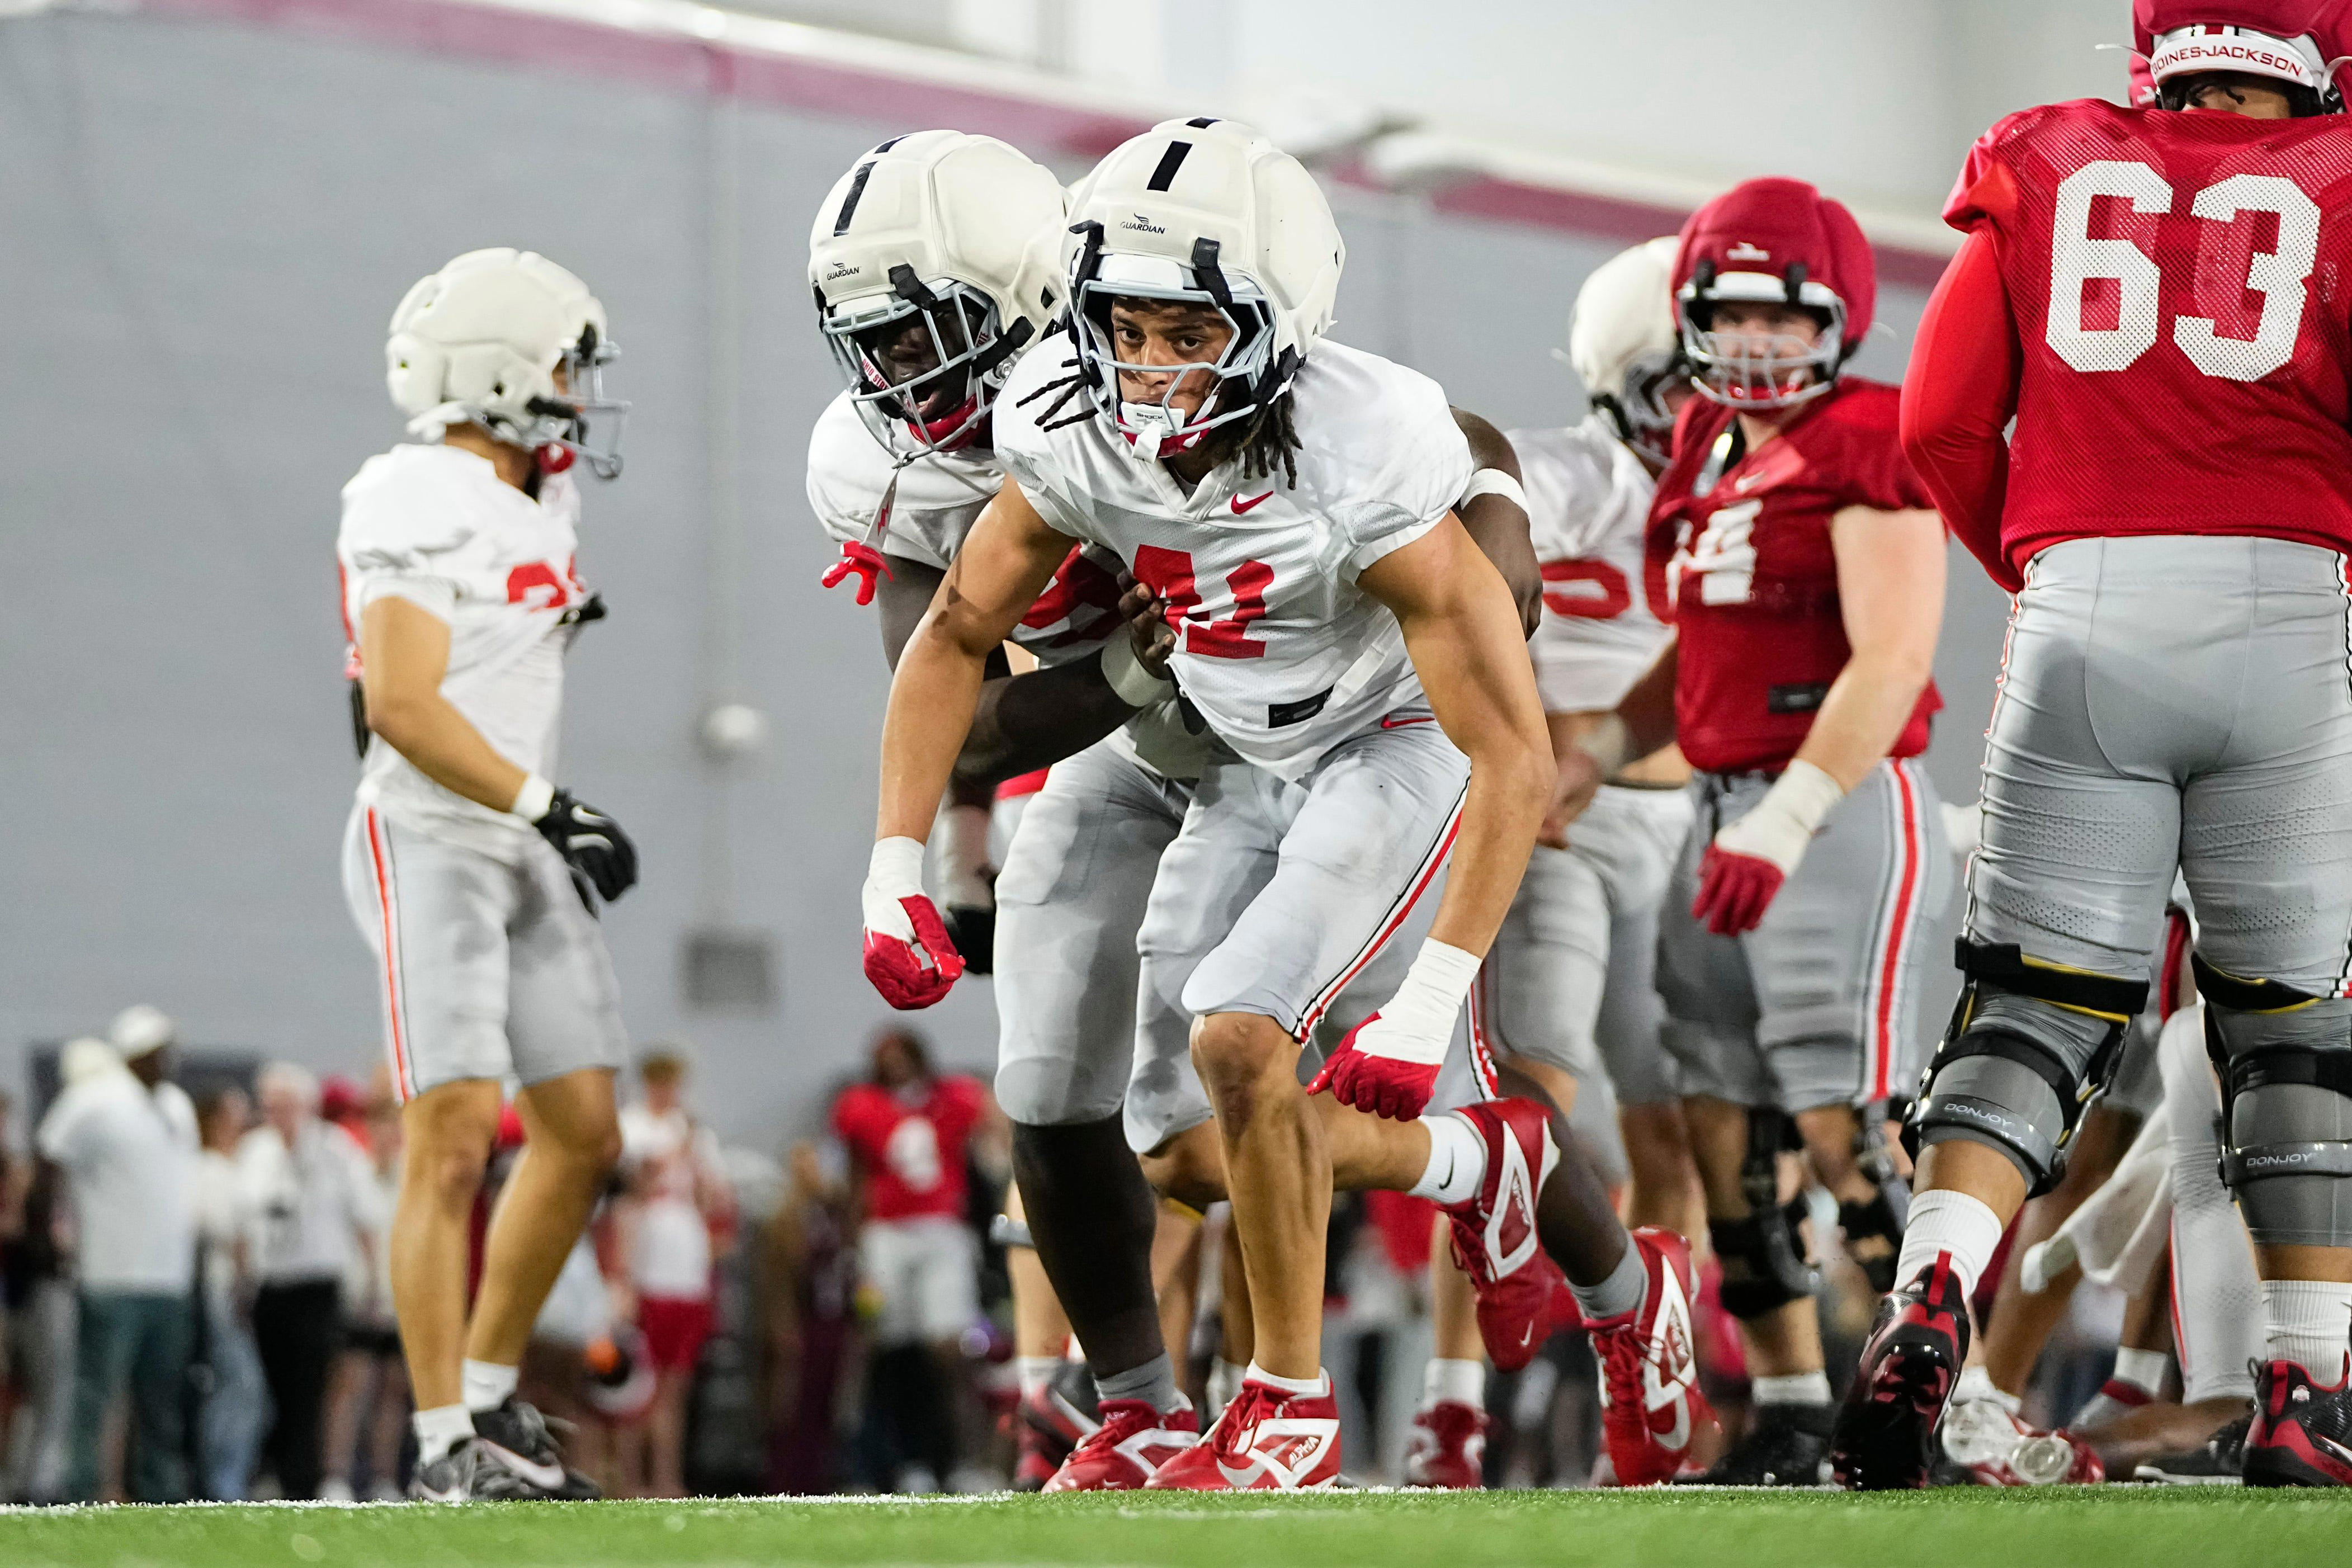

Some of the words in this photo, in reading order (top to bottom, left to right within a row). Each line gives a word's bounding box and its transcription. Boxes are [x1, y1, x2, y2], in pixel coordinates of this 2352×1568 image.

[1120, 221, 1165, 234] GUARDIAN
[827, 266, 859, 280] GUARDIAN
[2046, 159, 2321, 382] 63
[1944, 1103, 2013, 1127] DONJOY
[2246, 1152, 2315, 1167] DONJOY
